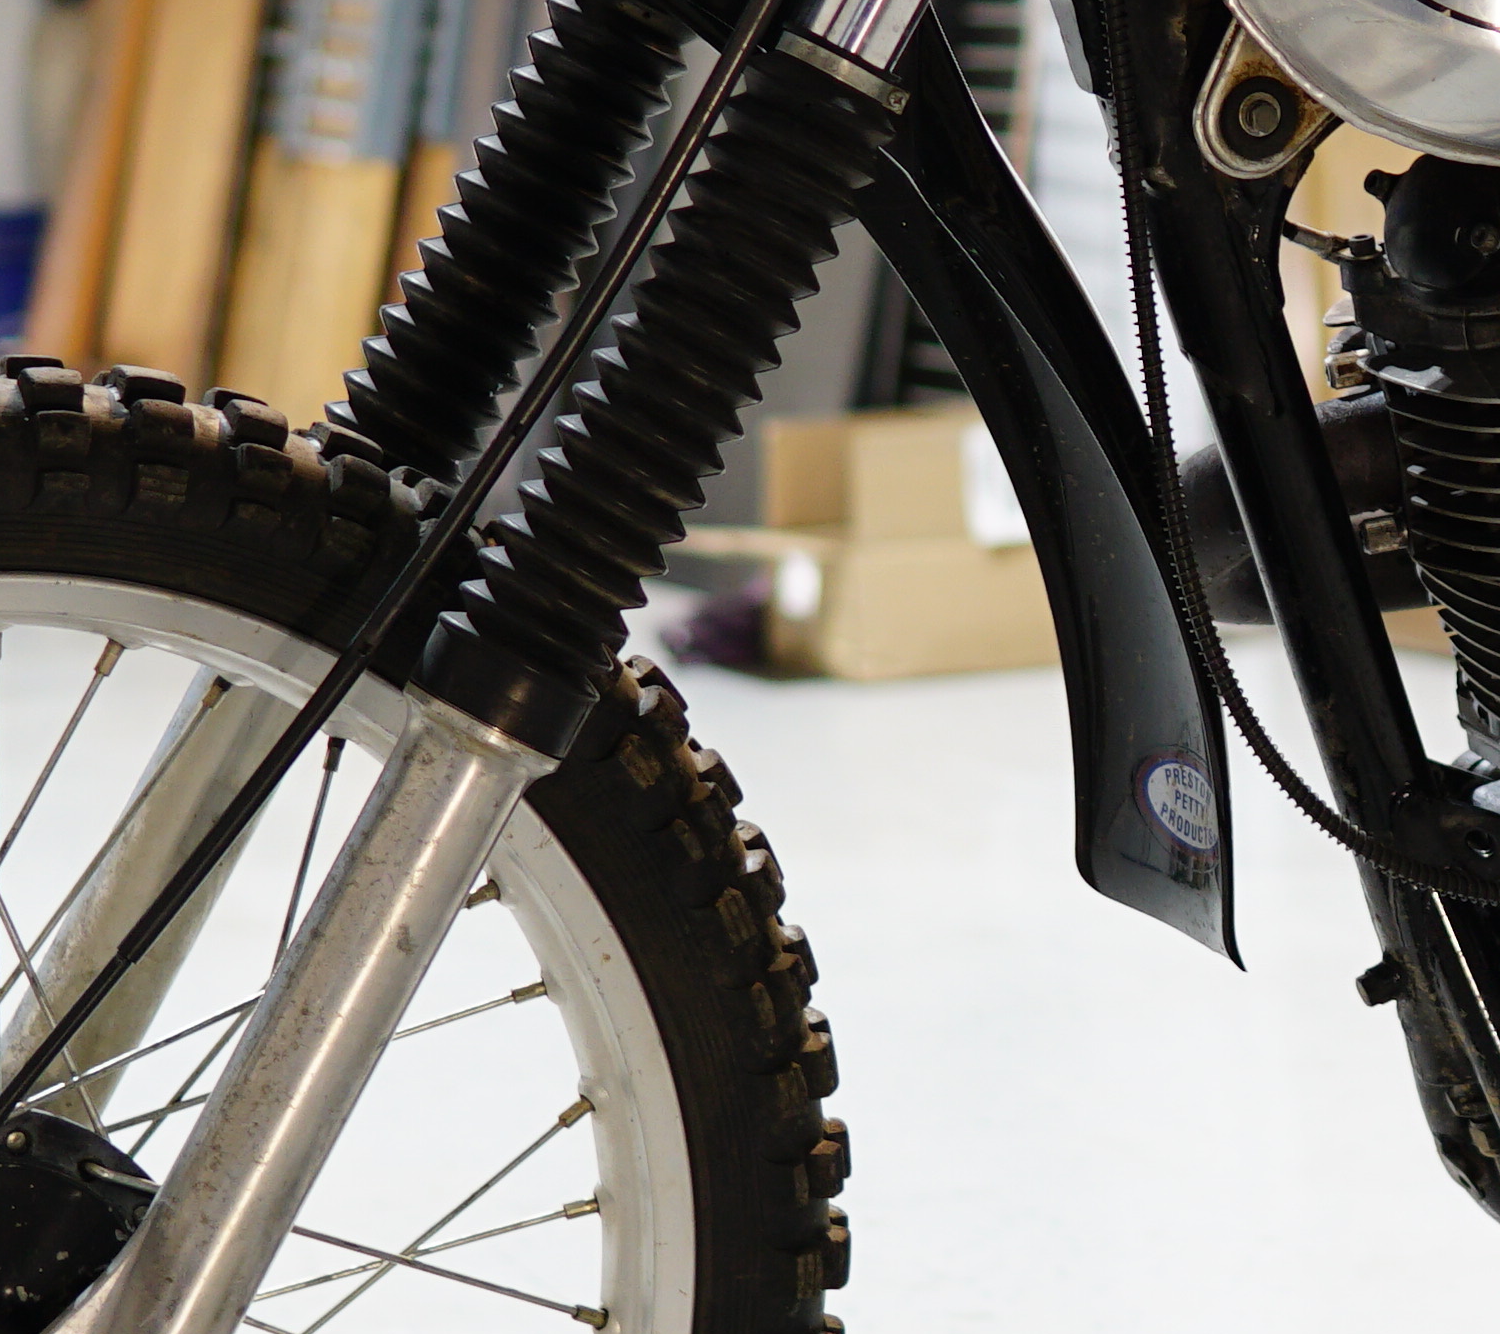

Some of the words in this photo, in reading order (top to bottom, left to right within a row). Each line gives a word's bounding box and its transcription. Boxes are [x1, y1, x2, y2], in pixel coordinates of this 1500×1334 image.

[1164, 767, 1212, 806] PRESTON
[1174, 788, 1208, 822] PETTY
[1160, 801, 1214, 846] PRODUCTS
